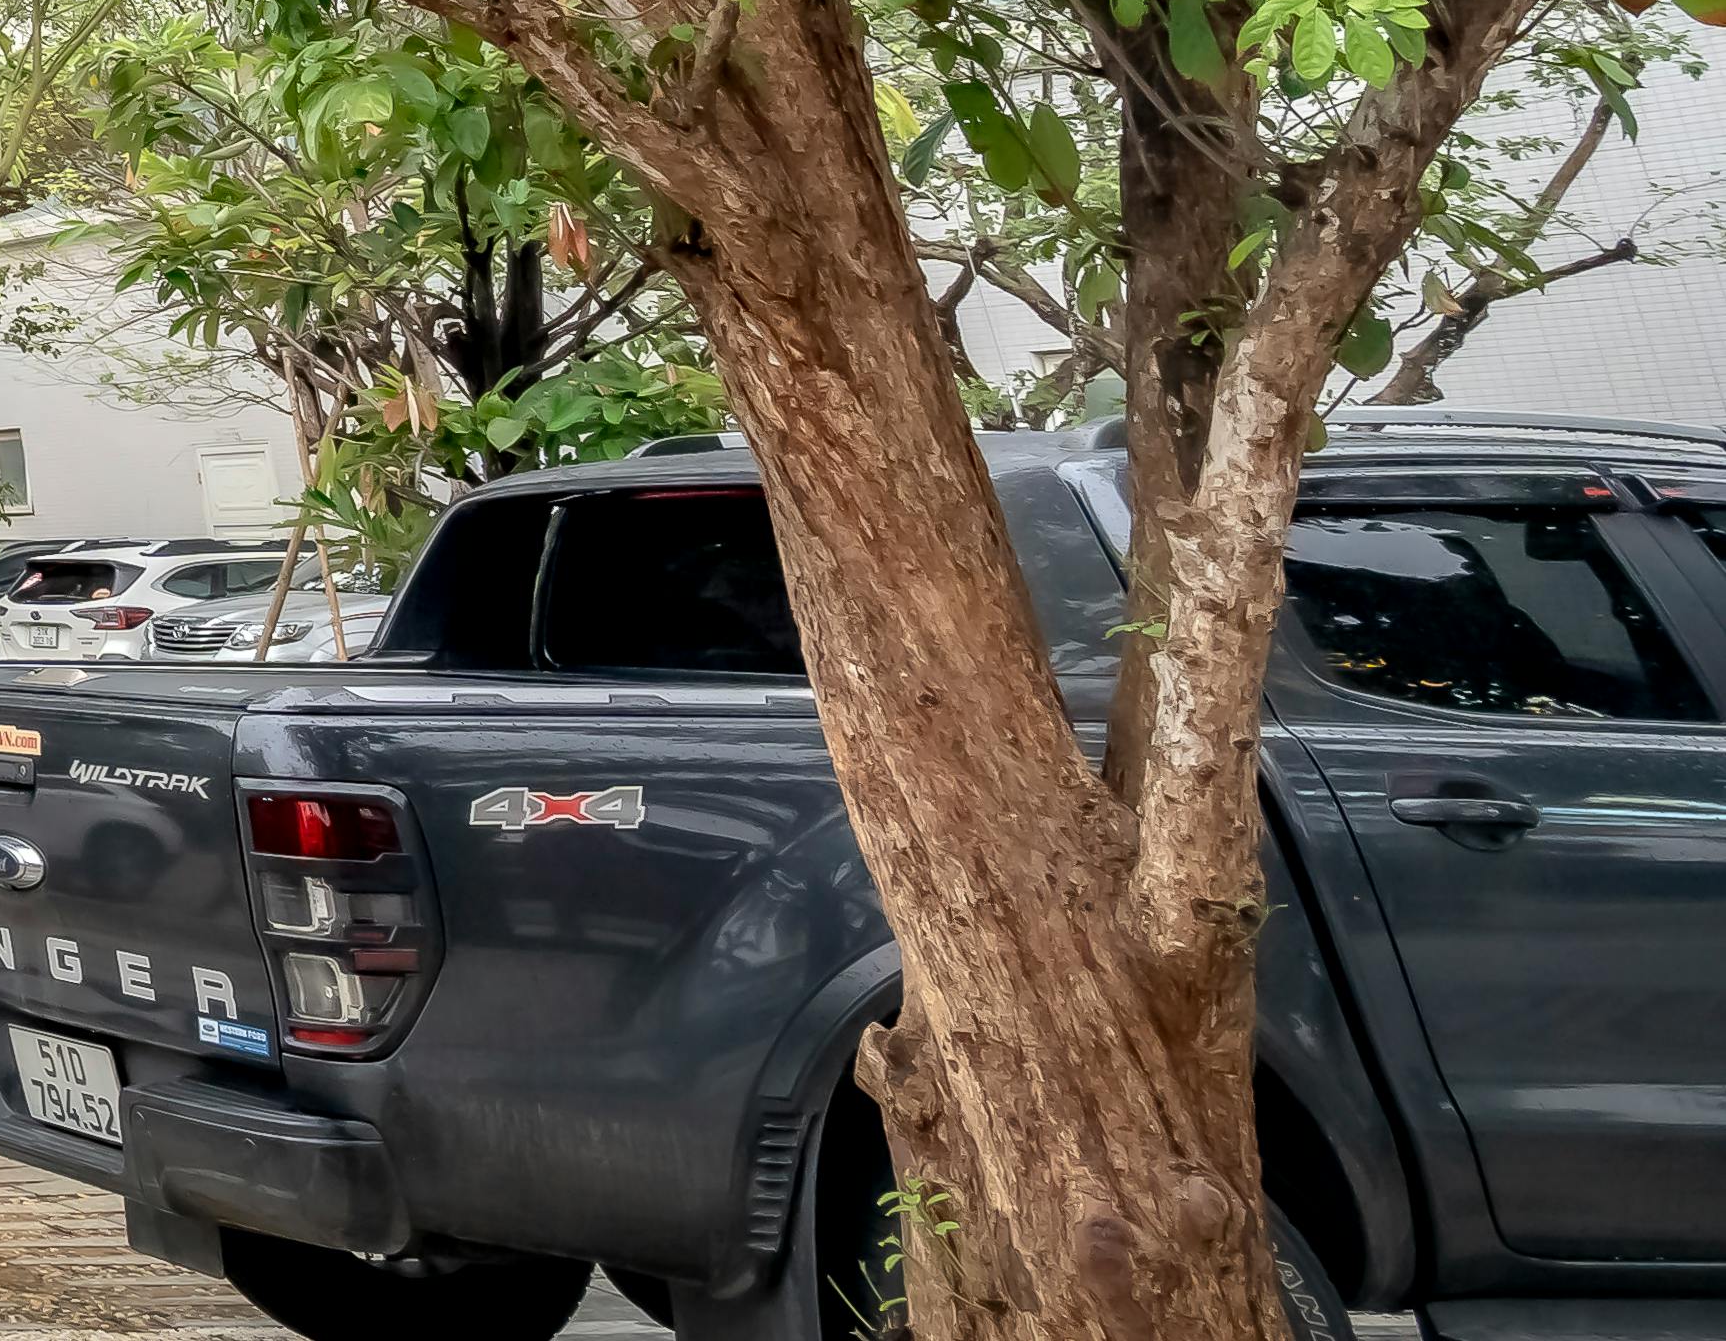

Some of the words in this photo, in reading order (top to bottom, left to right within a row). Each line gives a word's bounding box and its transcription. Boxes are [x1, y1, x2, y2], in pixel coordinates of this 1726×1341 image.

[69, 759, 211, 801] WILDTRAK
[37, 1038, 87, 1086] 51D
[30, 1078, 121, 1138] 794.52
